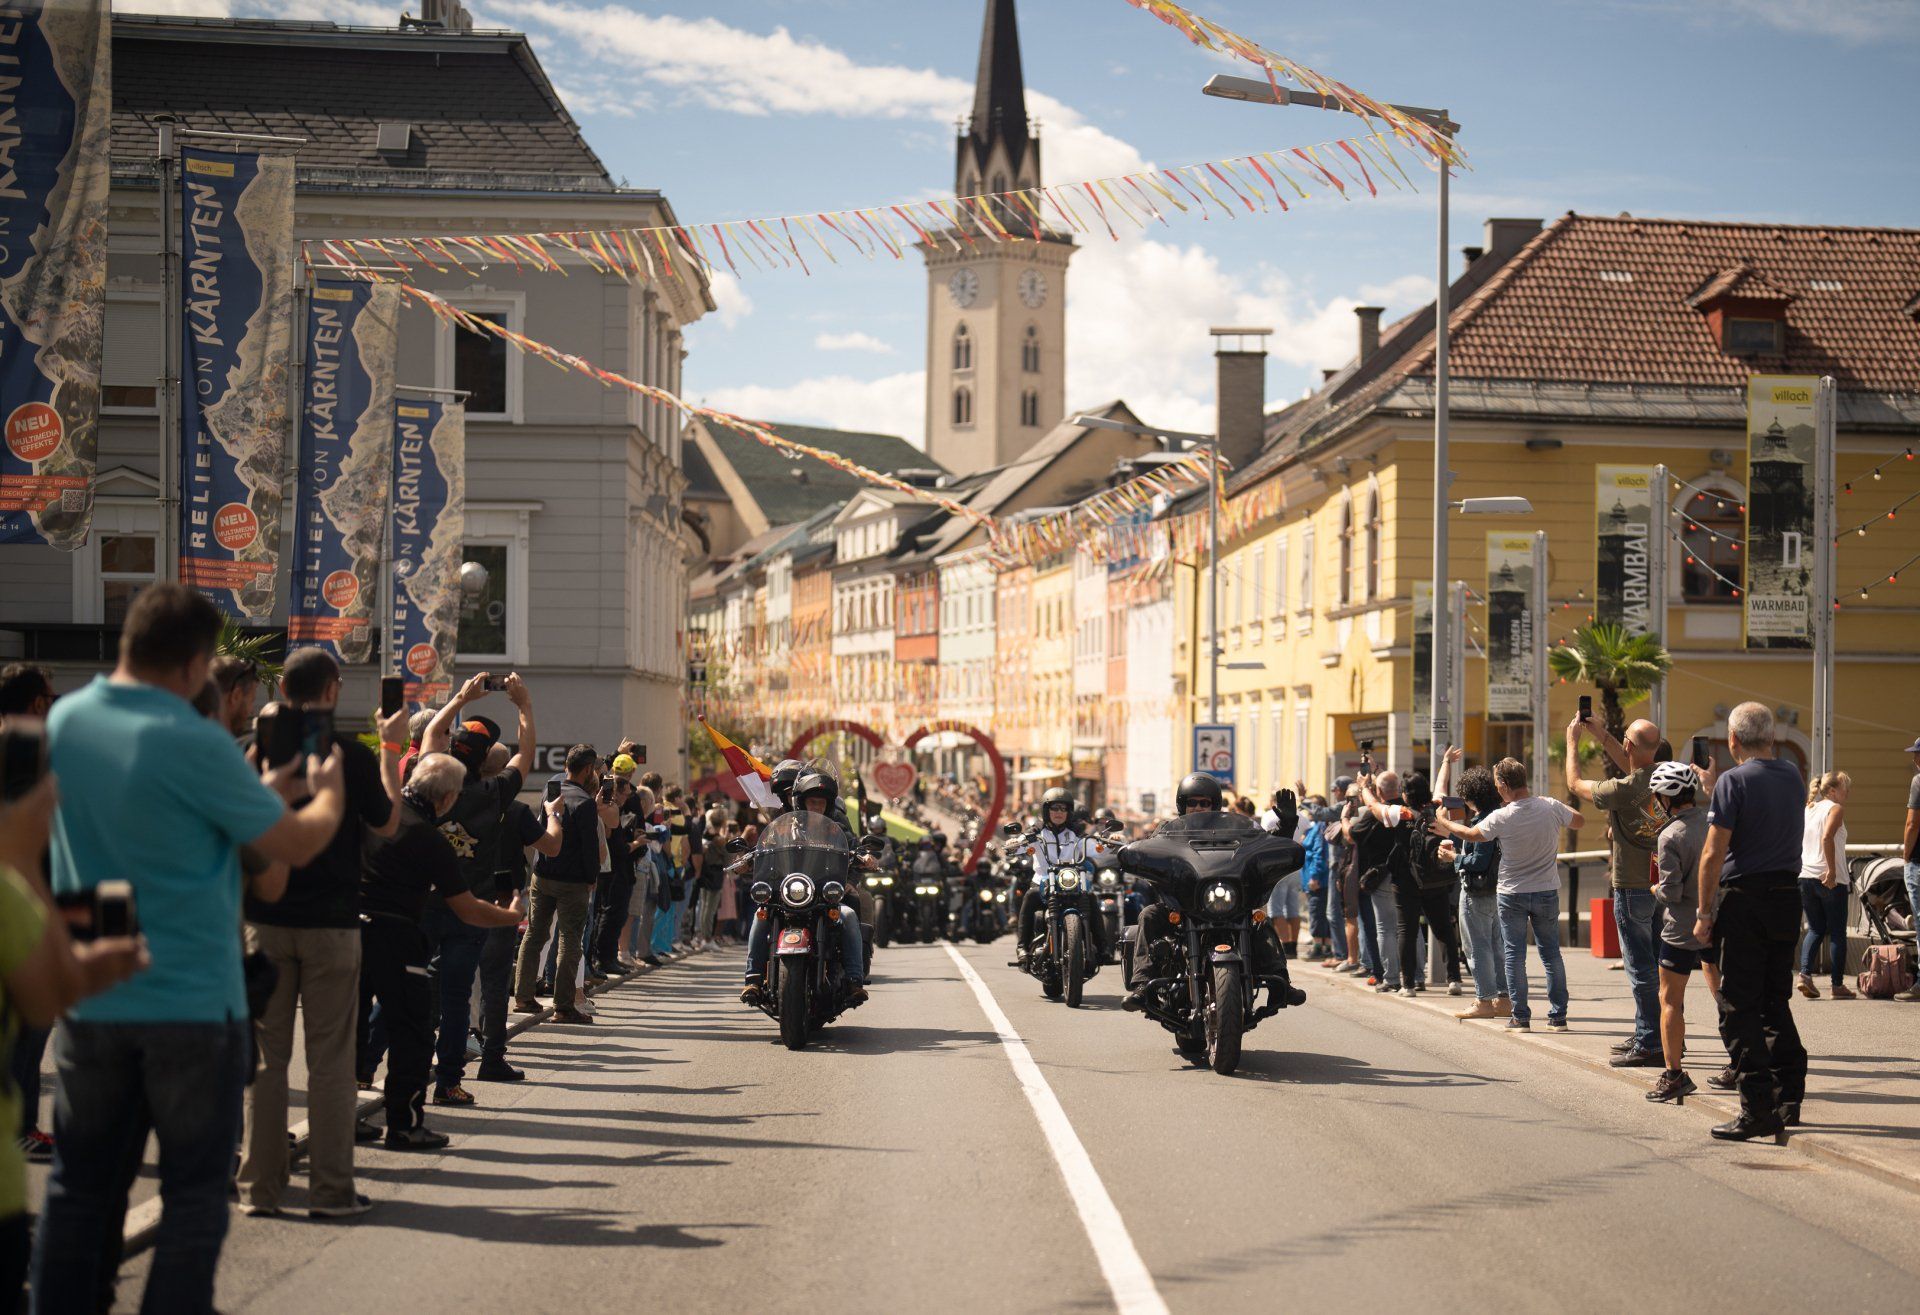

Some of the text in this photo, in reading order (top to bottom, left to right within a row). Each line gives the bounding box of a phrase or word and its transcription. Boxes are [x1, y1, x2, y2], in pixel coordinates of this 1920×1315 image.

[184, 182, 224, 347] KÄRNTEN
[305, 307, 343, 440] KÄRNTEN
[1775, 390, 1808, 401] villach
[14, 413, 50, 433] NEU
[11, 429, 60, 447] MULTIMEDIA
[20, 437, 55, 454] EFFEKTE
[396, 423, 424, 535] KÄRNTEN
[1617, 476, 1646, 486] villach
[190, 432, 212, 548] RELIEF
[219, 512, 248, 527] NEU
[217, 525, 256, 537] MULTIMEDIA
[224, 532, 252, 543] EFFEKTE
[303, 512, 324, 608] RELIEF
[328, 577, 352, 590] NEU
[1623, 522, 1648, 637] WARMBAD
[1751, 600, 1805, 612] WARMBAD
[391, 594, 408, 676] RELIEF
[1510, 619, 1520, 655] BADEN
[412, 649, 431, 660] NEU
[1216, 757, 1229, 768] 20
